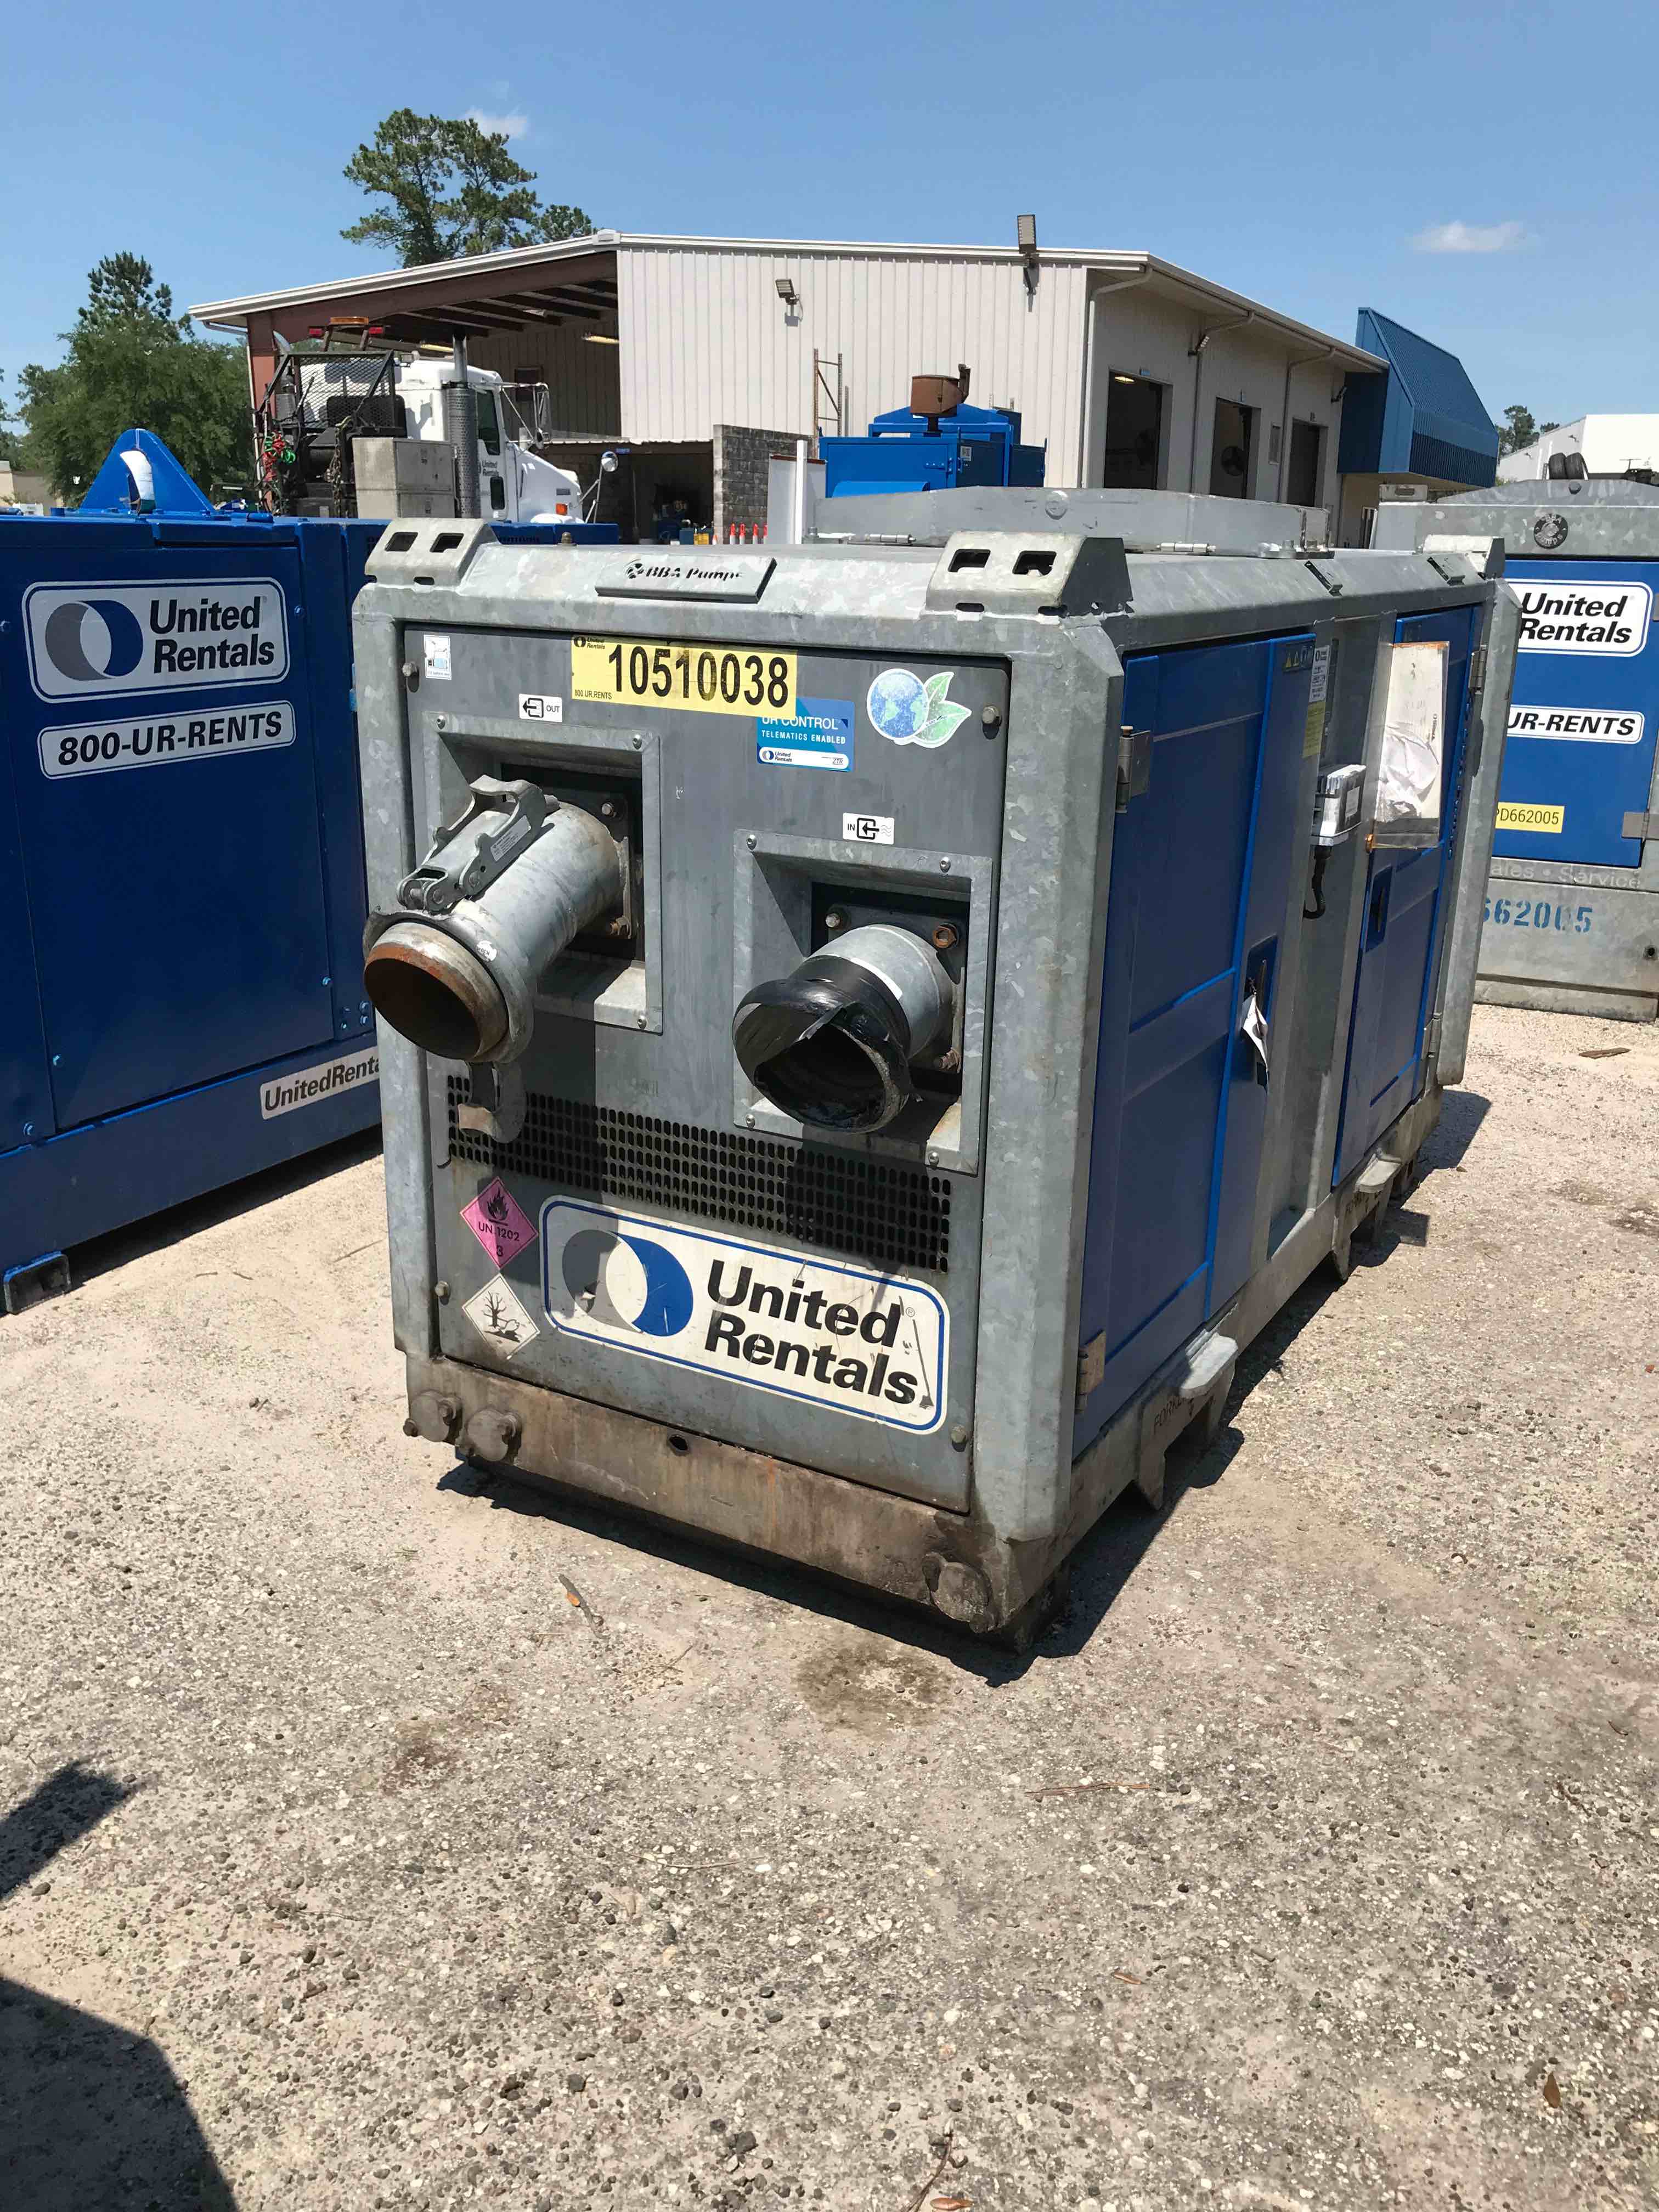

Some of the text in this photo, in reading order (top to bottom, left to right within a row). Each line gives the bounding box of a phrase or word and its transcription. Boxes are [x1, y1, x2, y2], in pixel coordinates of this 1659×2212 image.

[149, 596, 261, 634] United
[1522, 592, 1628, 617] United
[1519, 618, 1632, 643] Rentals
[154, 634, 275, 674] Rentals
[609, 644, 788, 708] 10510038
[546, 704, 560, 713] OUT
[781, 715, 838, 730] CONTROL
[58, 711, 282, 765] 800-UR-RENTS
[761, 730, 845, 744] TELEMATICS ENABLED
[478, 1221, 520, 1242] UN 1202
[496, 1245, 504, 1257] 3
[707, 1259, 901, 1348] United
[704, 1310, 918, 1404] Rentals
